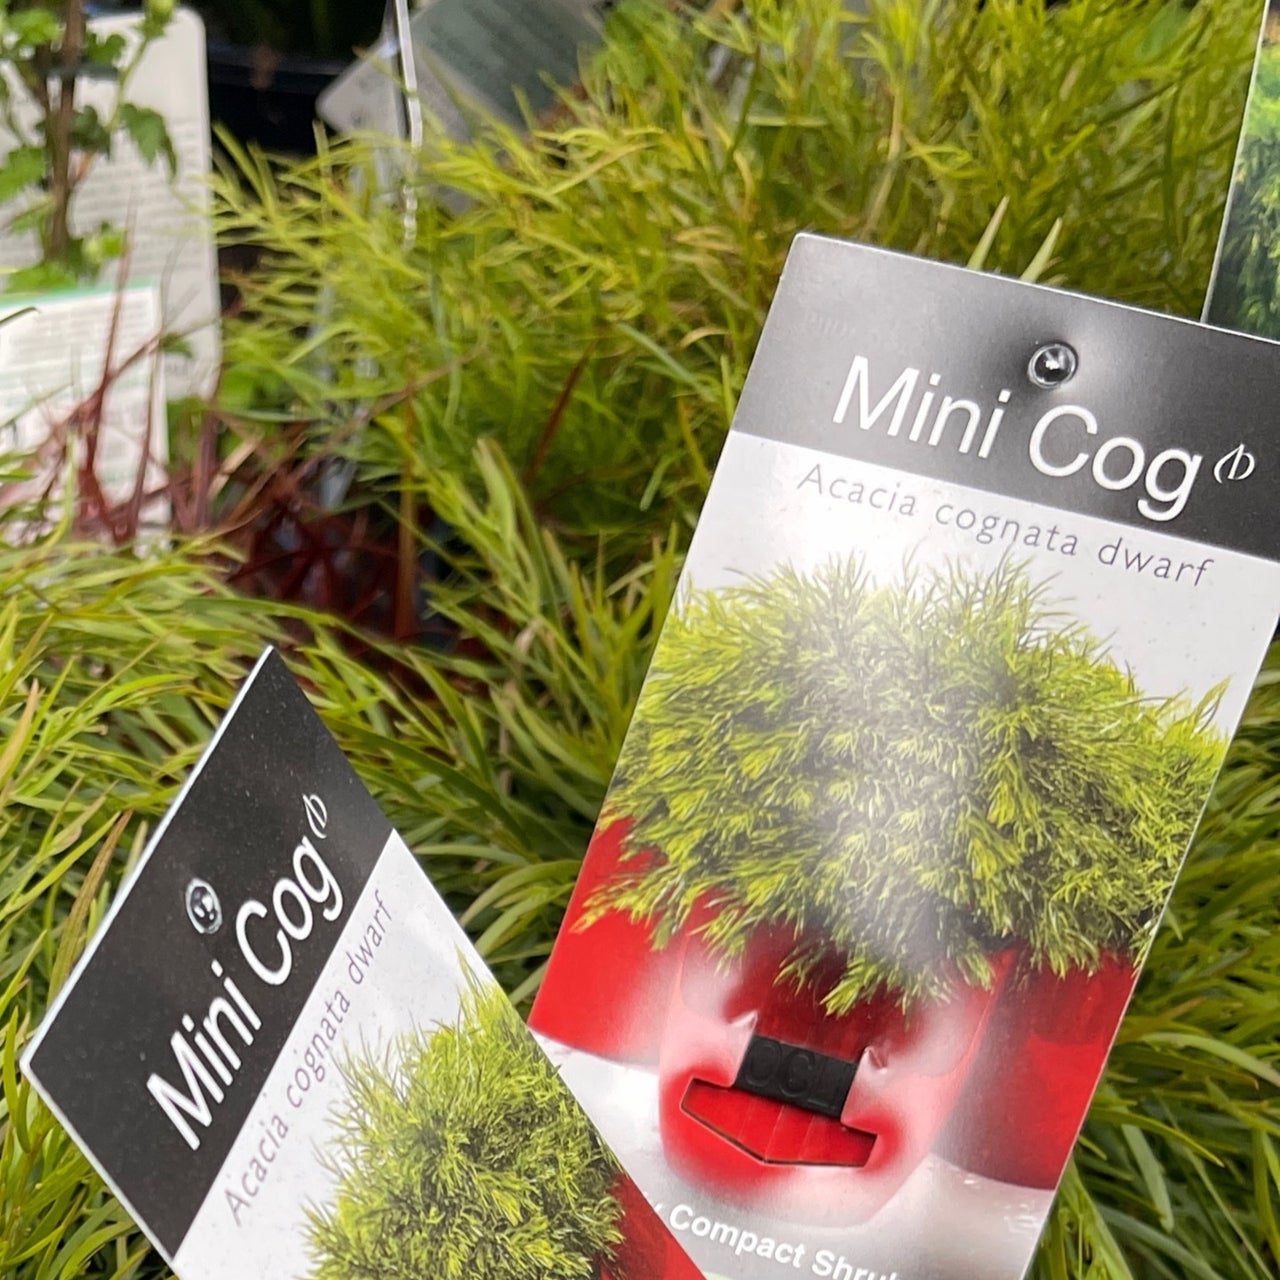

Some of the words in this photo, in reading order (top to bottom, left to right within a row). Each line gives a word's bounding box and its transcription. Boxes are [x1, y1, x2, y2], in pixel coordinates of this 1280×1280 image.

[832, 355, 1010, 459] Mini
[1029, 404, 1202, 522] Cog
[799, 463, 917, 518] Acacia
[935, 503, 1078, 557] cognata
[1097, 538, 1215, 588] dwarf
[146, 960, 262, 1151] Mini
[235, 836, 344, 986] Cog
[225, 1113, 290, 1227] Acacia
[286, 990, 350, 1110] cognata
[347, 888, 393, 986] dwarf
[669, 1203, 805, 1269] Compact
